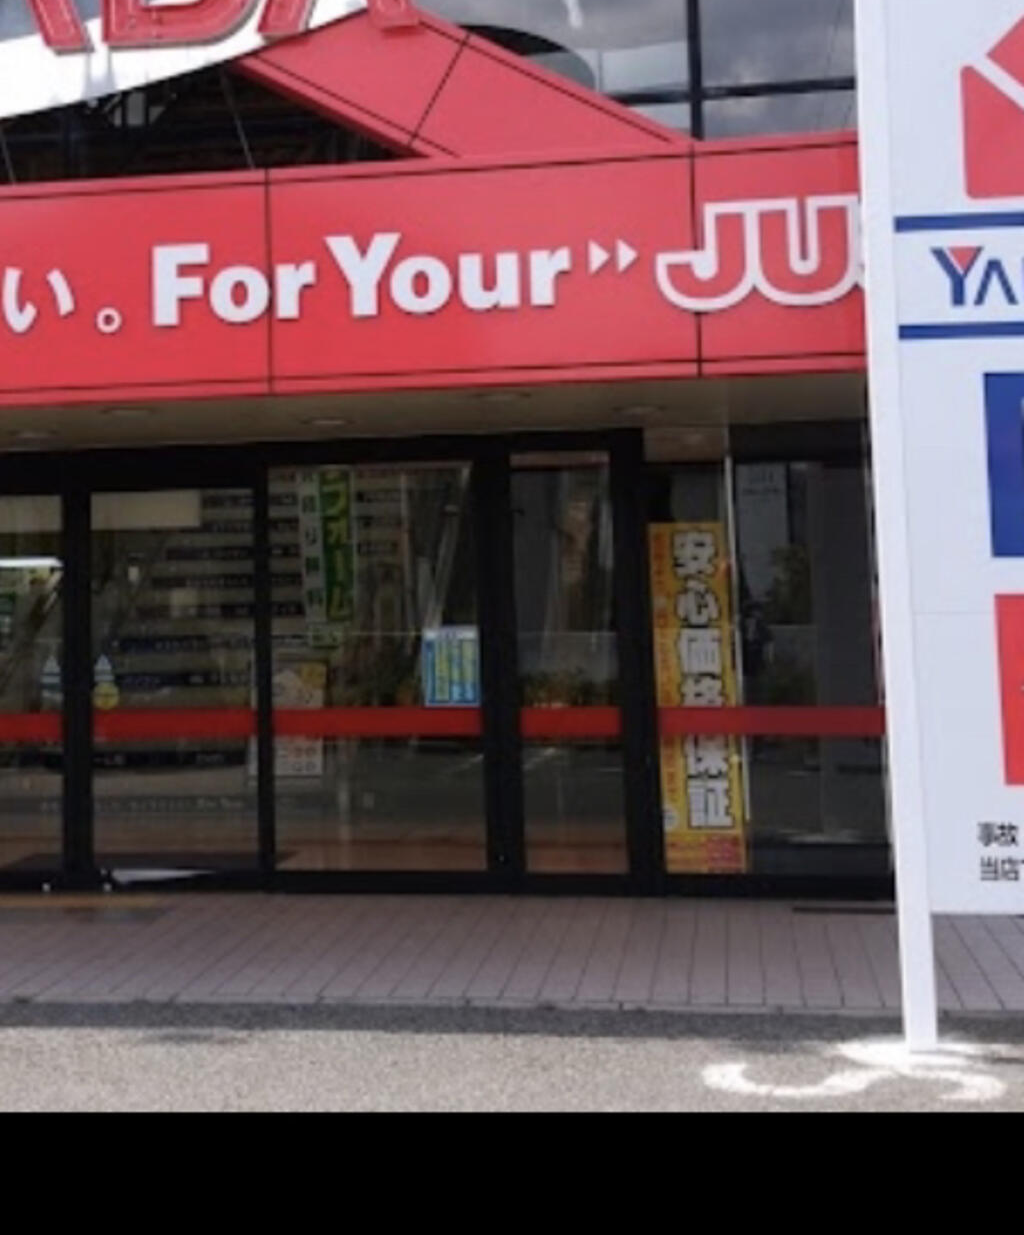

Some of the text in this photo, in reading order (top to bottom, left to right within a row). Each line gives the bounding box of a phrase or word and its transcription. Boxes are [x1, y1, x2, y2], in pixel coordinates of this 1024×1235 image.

[151, 231, 572, 327] For Your
[656, 193, 865, 313] JU
[930, 245, 1024, 307] YA
[980, 856, 1024, 882] 当店
